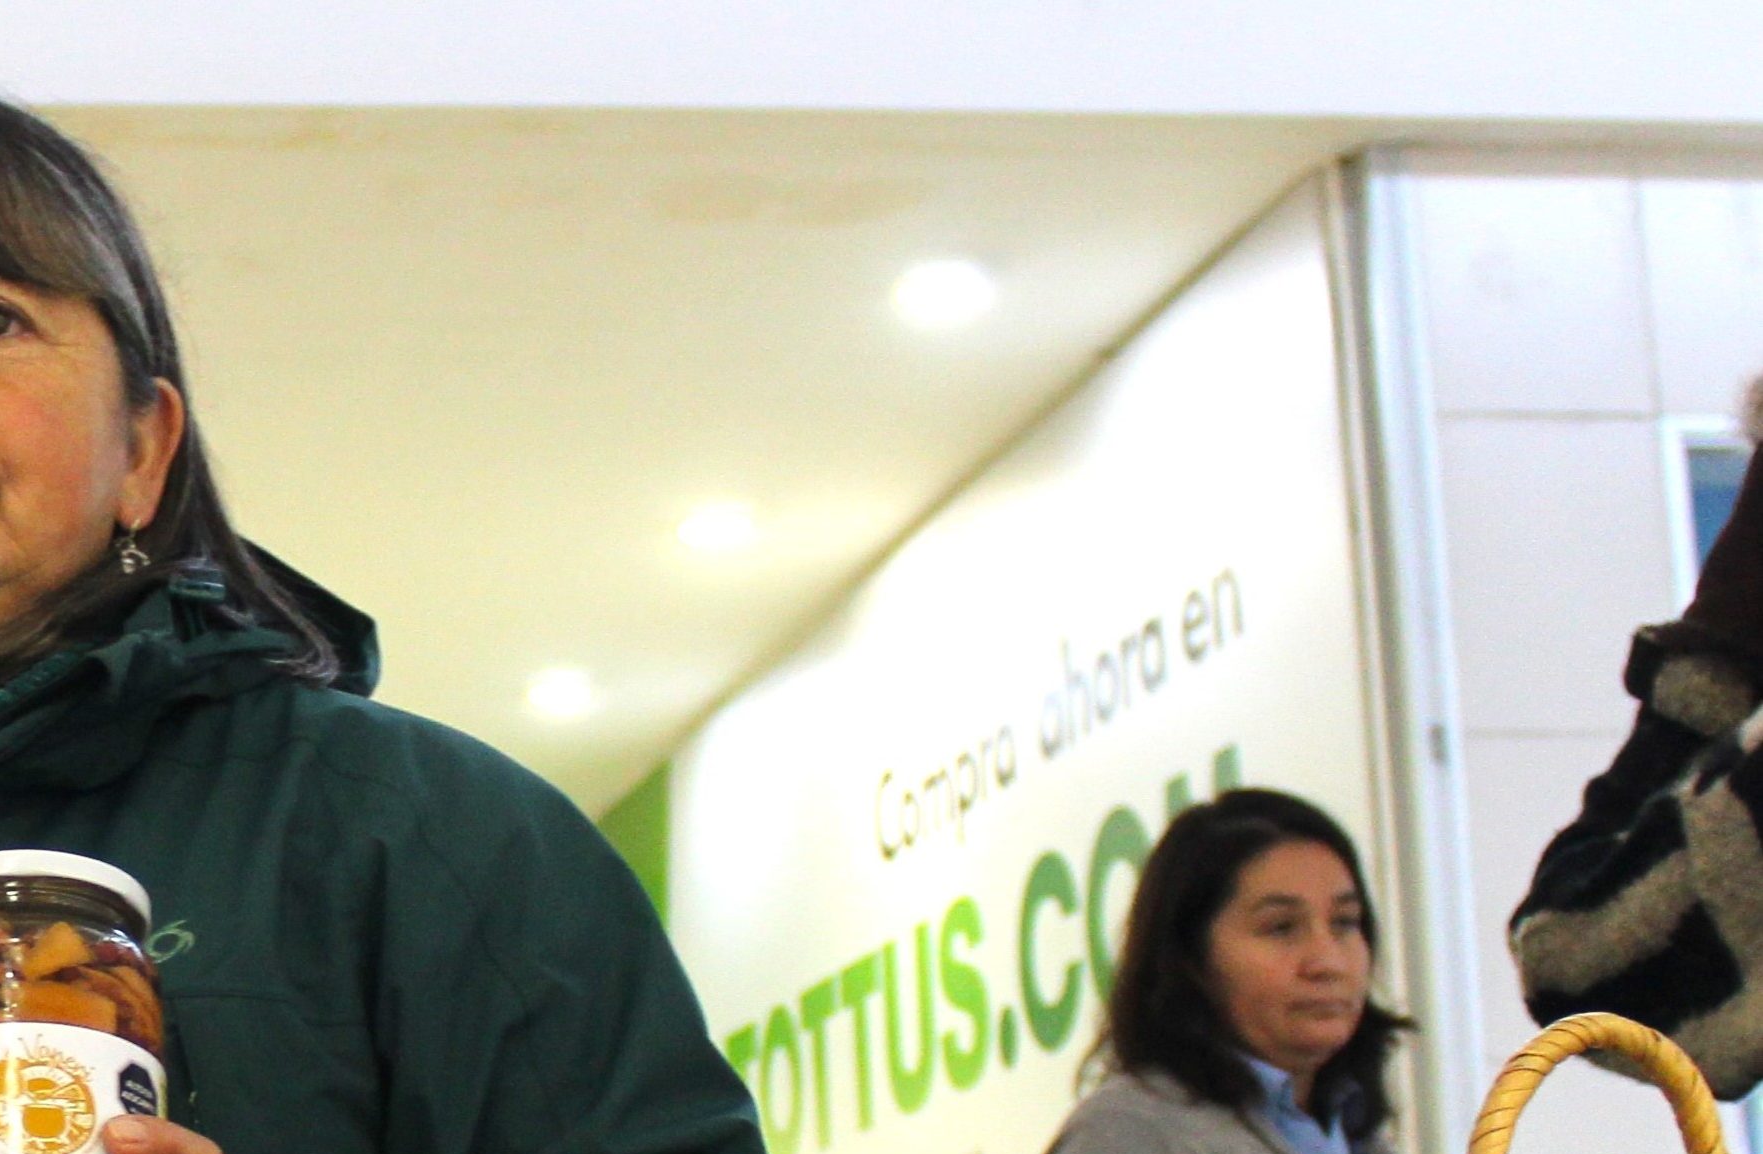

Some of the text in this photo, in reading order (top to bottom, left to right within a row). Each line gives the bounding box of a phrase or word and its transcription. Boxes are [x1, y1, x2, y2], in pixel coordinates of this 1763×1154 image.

[876, 567, 1243, 862] Compra ahora en
